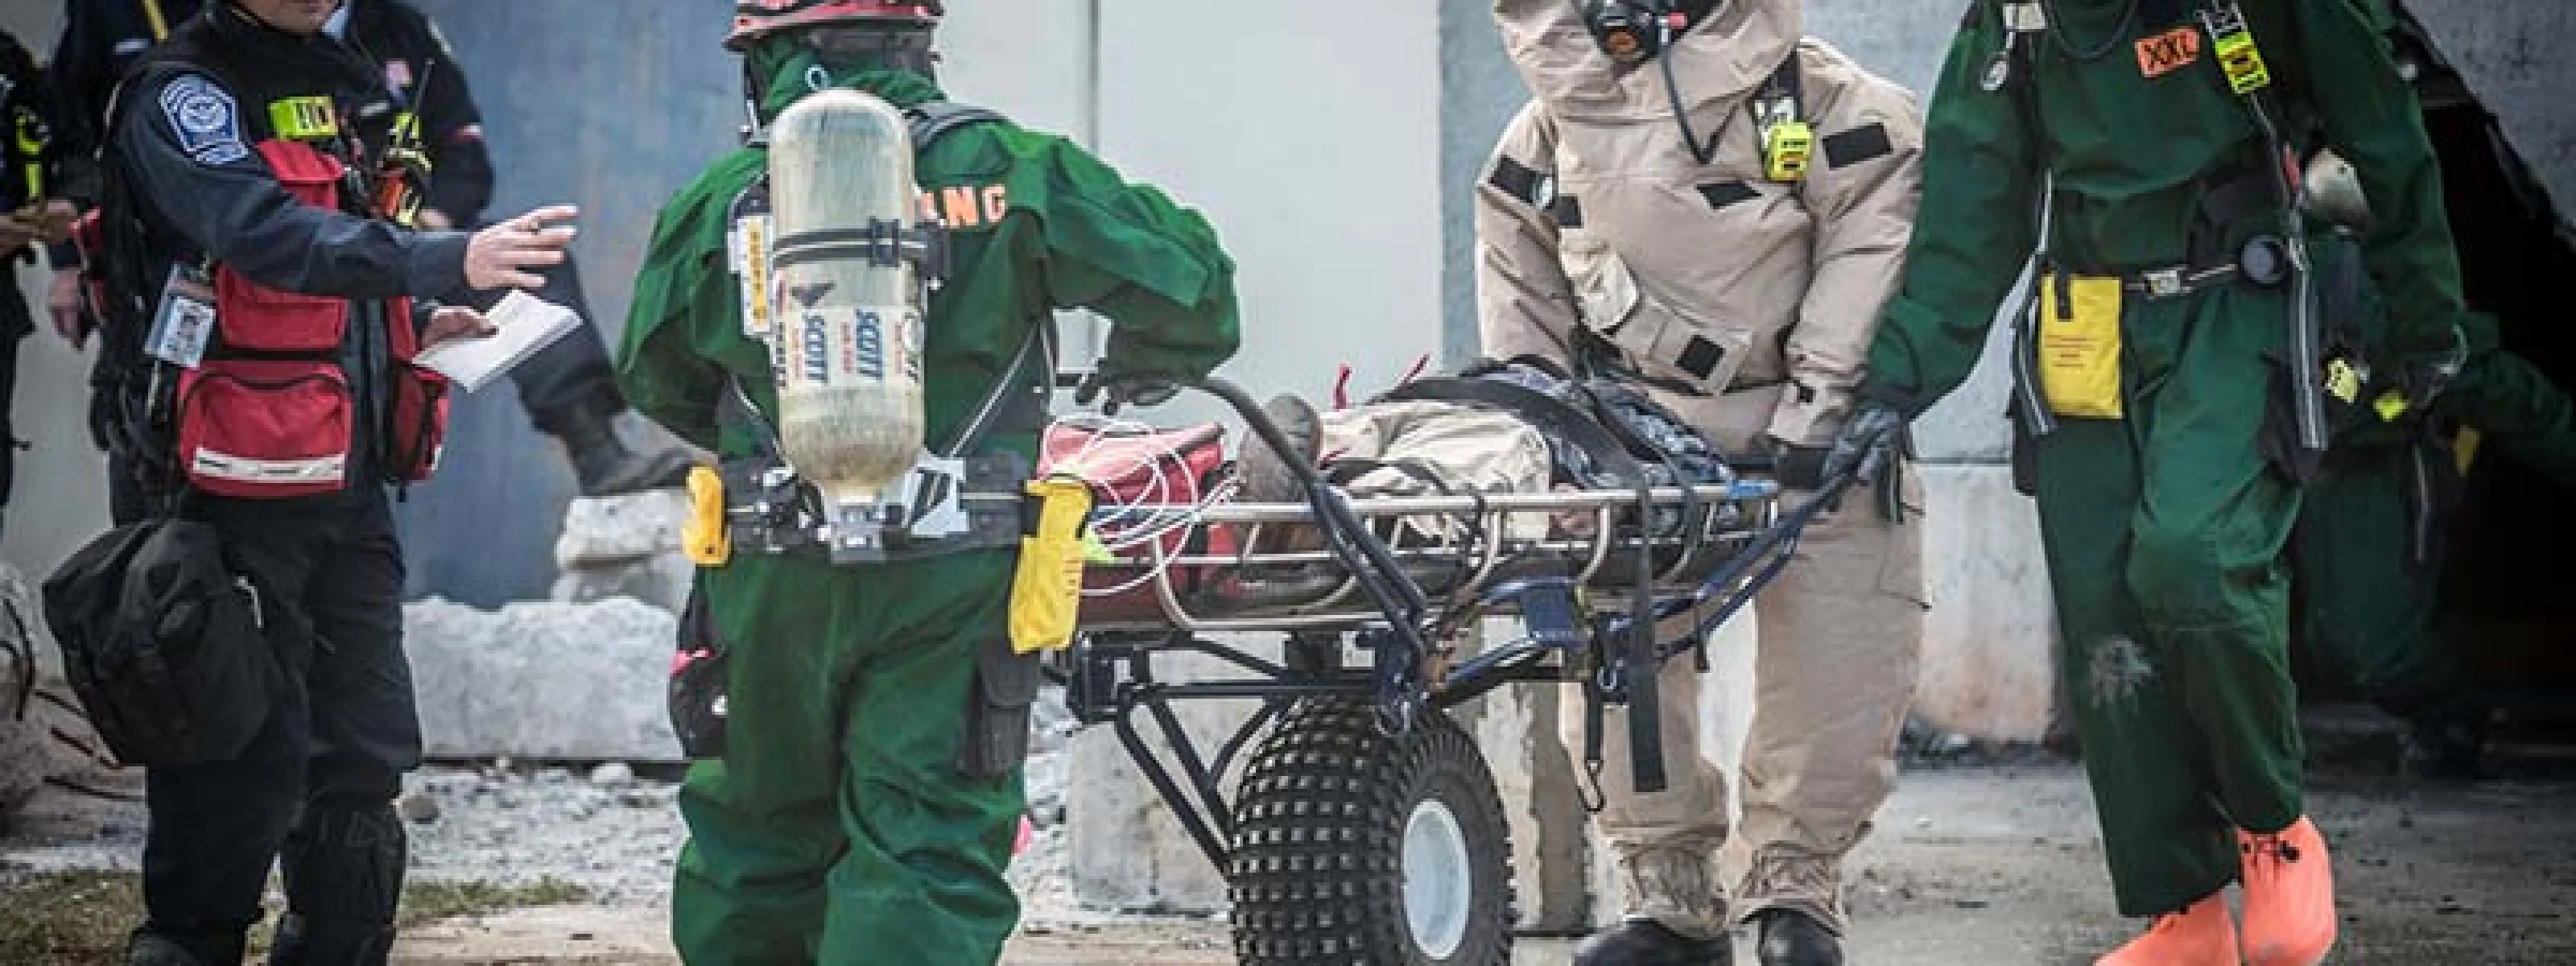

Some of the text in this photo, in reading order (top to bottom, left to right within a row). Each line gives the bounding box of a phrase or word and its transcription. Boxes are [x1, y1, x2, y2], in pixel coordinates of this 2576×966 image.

[2143, 33, 2196, 72] XXL
[803, 313, 828, 384] SCOTT
[856, 309, 883, 380] SCOTT
